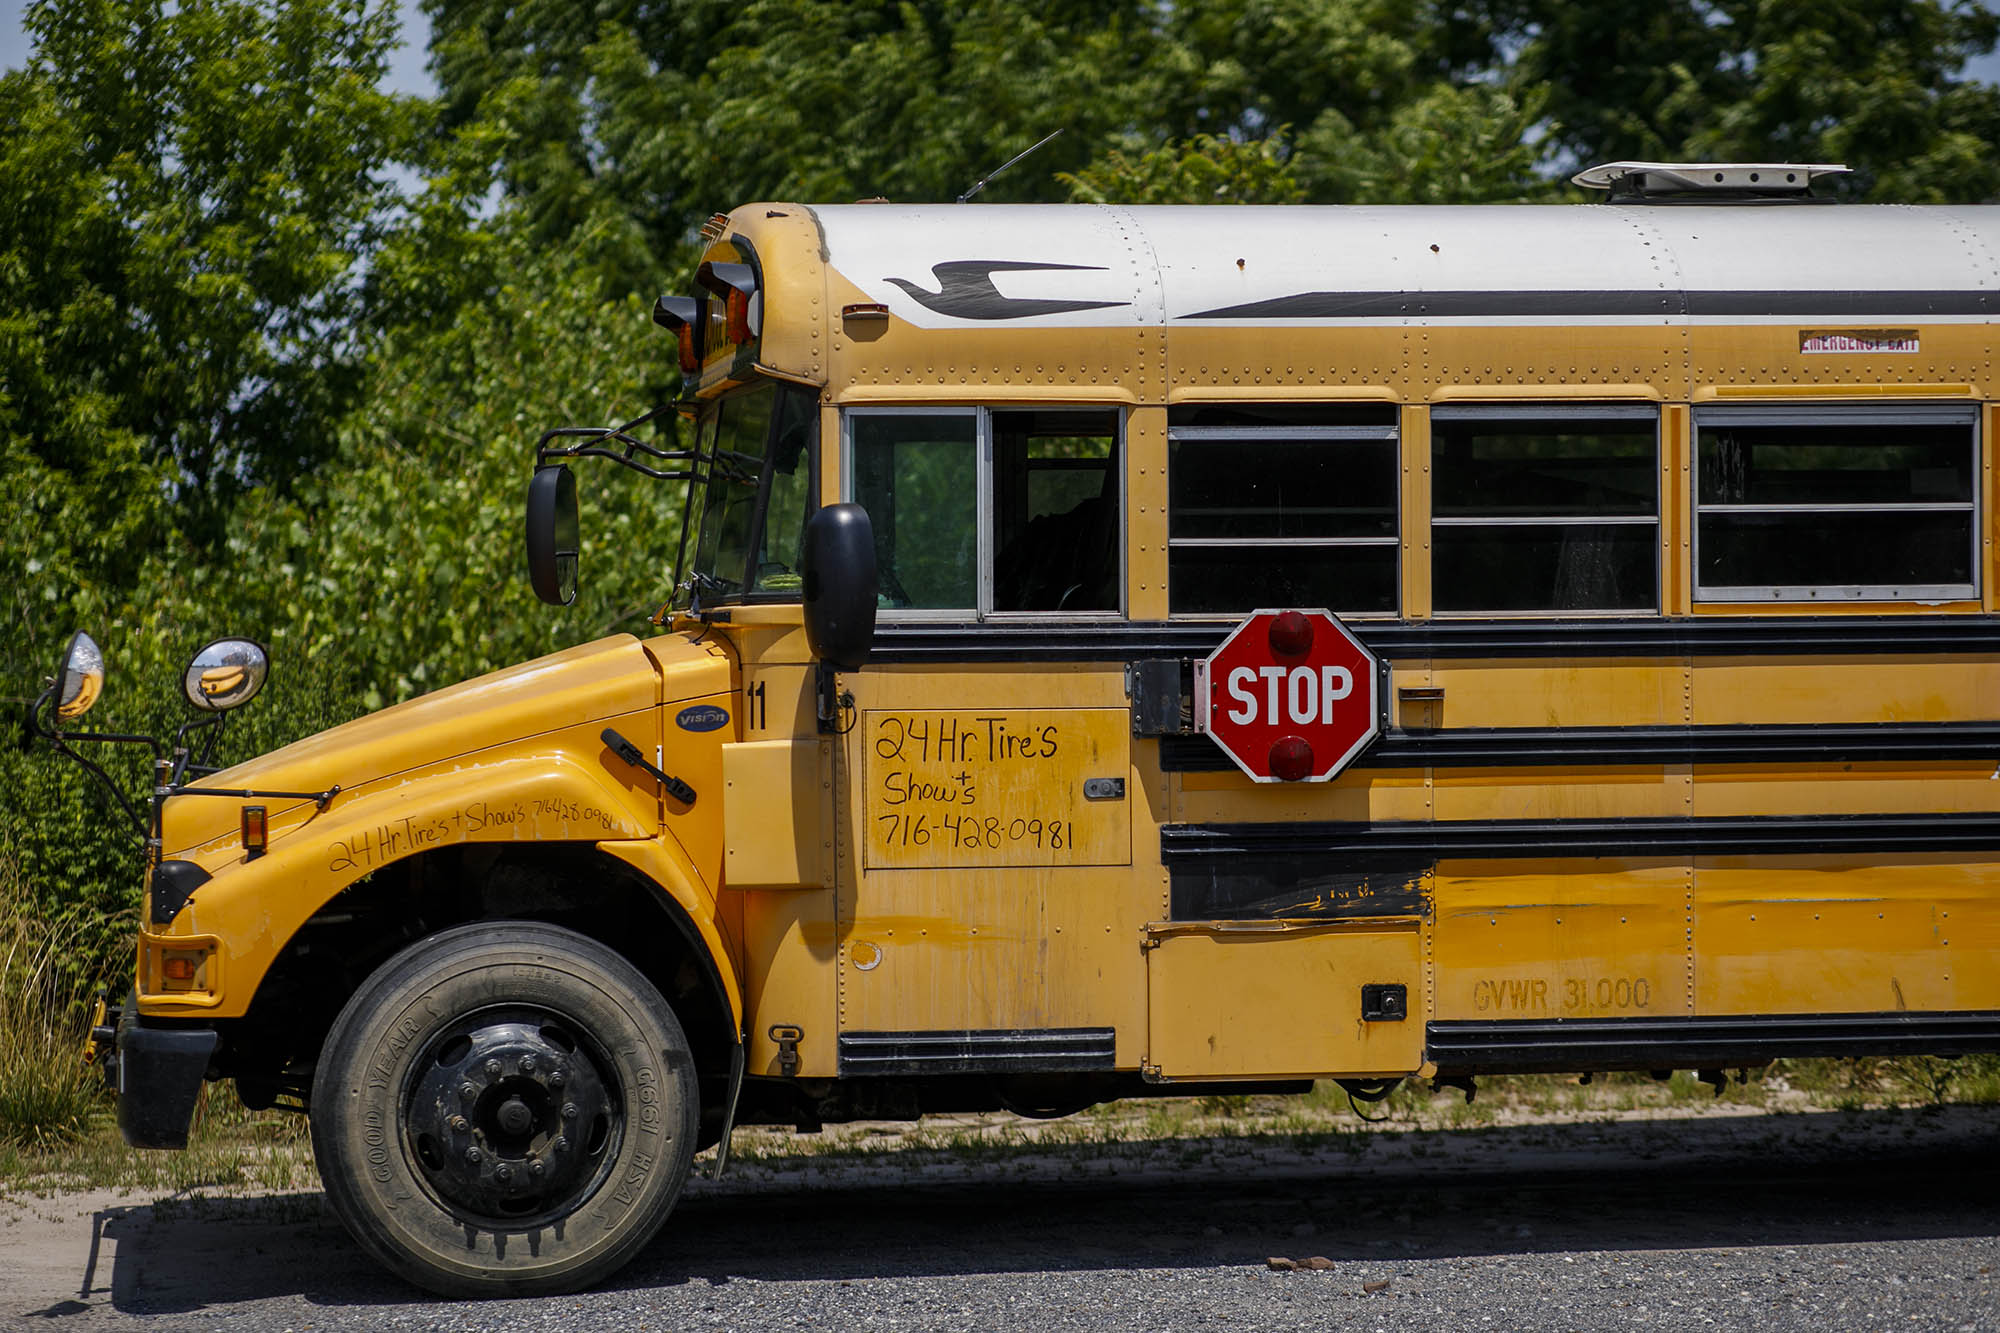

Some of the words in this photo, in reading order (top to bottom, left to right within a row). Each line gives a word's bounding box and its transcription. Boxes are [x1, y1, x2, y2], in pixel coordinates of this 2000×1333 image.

[747, 680, 766, 730] 11
[1227, 665, 1354, 726] STOP
[876, 717, 928, 762] 24
[938, 718, 978, 762] Hr.
[975, 717, 1058, 762] Tire's
[327, 831, 371, 872] 24
[465, 802, 525, 832] Show's
[1473, 979, 1548, 1011] GVWR
[368, 1015, 421, 1089] YEAR
[637, 1066, 660, 1136] G661
[363, 1109, 393, 1183] GOOD
